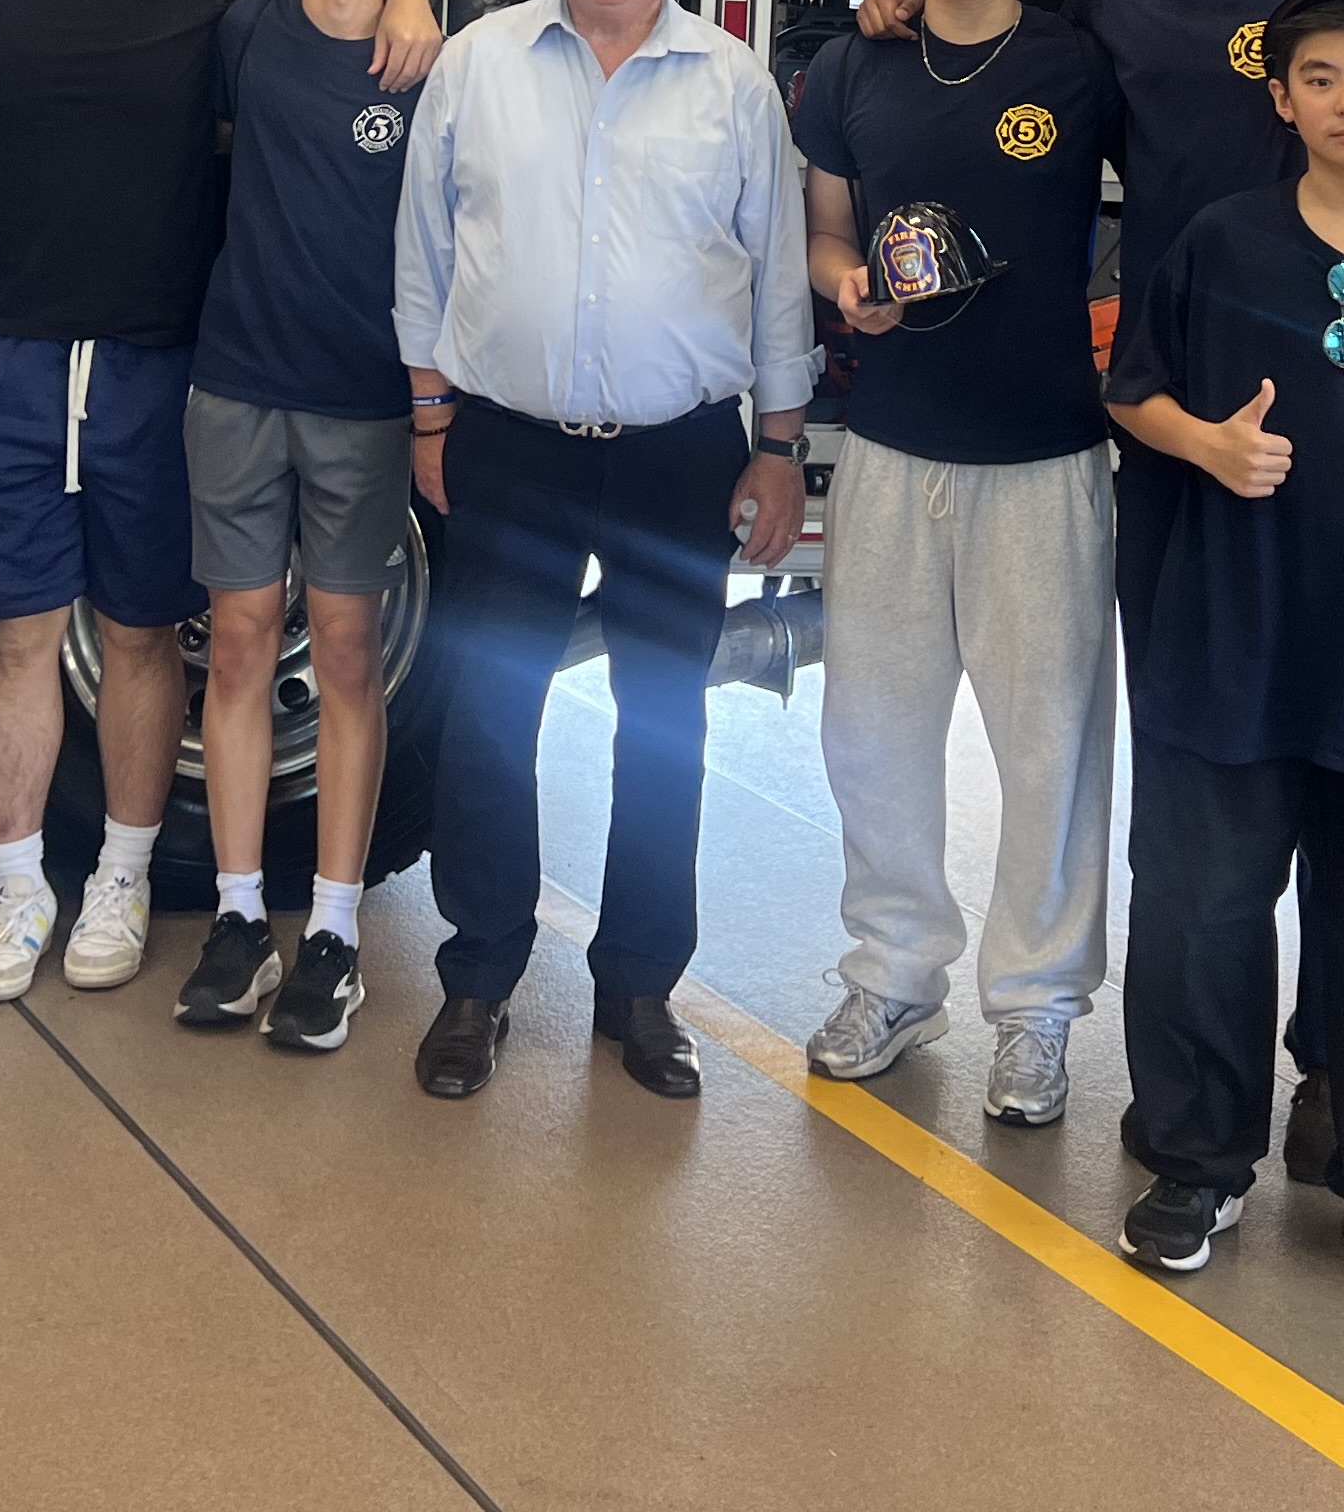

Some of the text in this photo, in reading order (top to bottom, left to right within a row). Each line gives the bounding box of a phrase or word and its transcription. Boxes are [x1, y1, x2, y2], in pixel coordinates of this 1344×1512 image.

[367, 117, 390, 141] 5
[1017, 120, 1036, 142] 5
[887, 230, 917, 246] FIRE
